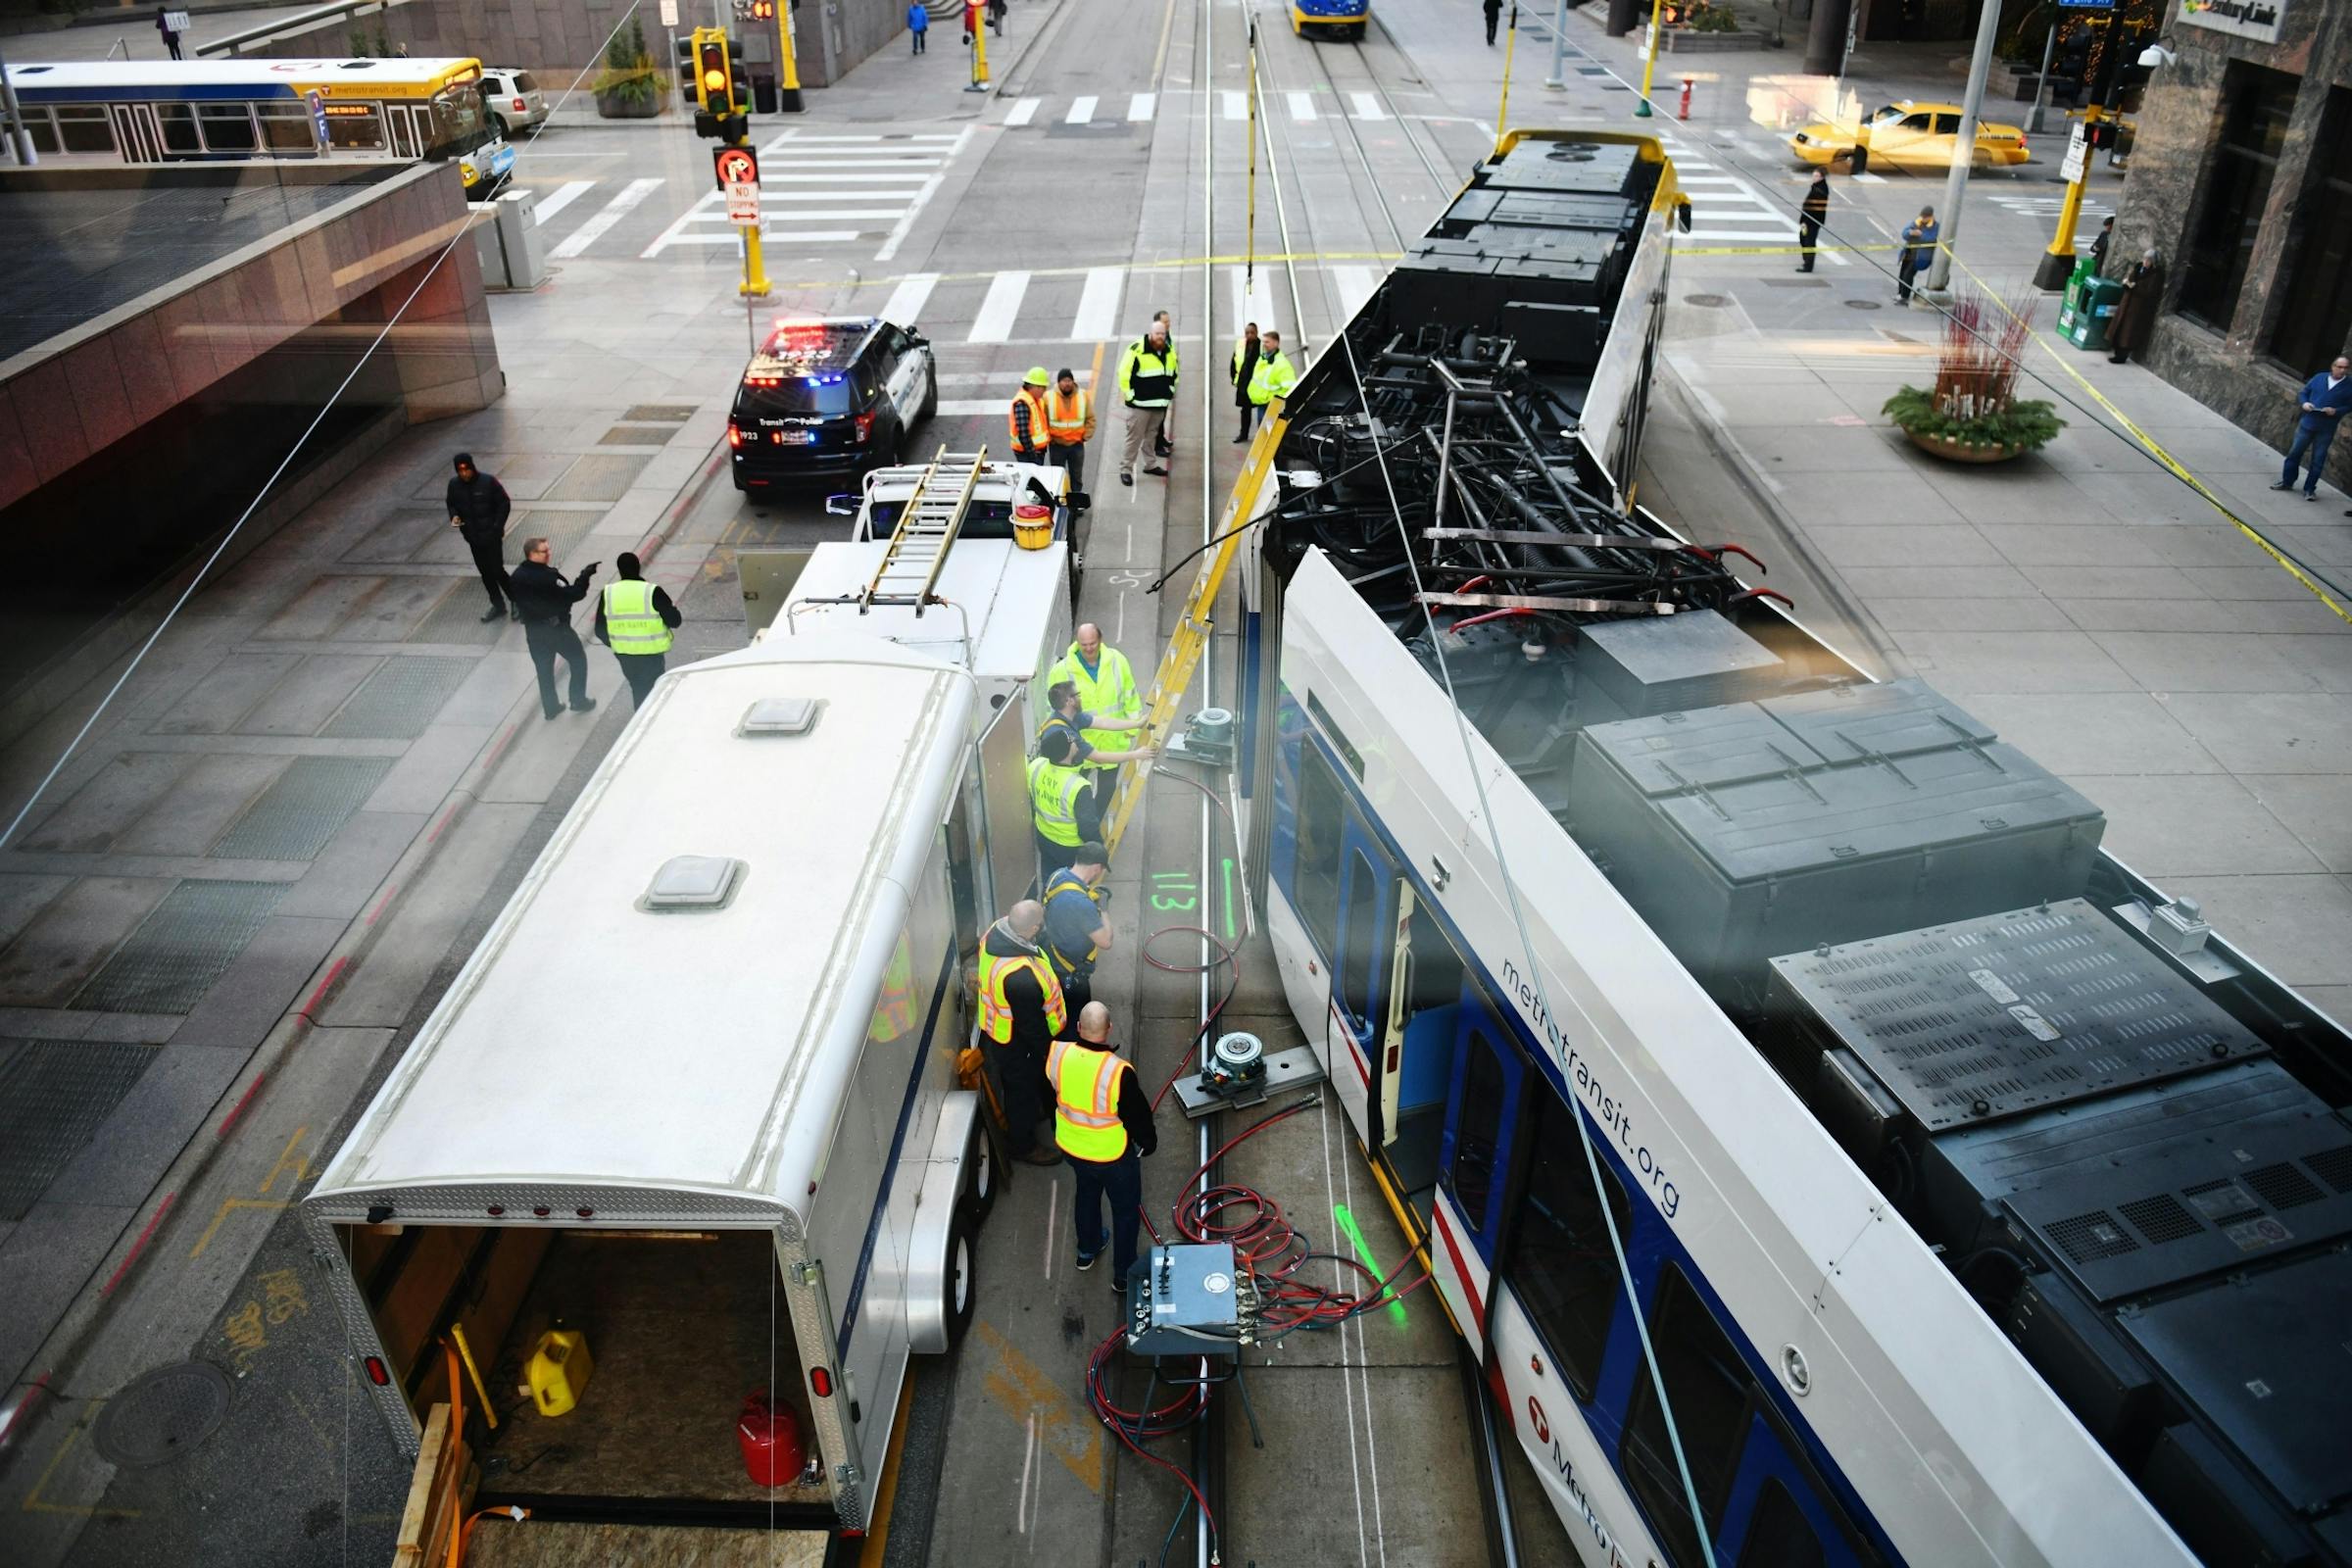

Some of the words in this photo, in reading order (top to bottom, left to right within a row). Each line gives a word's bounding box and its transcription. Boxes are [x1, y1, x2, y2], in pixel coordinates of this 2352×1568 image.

[335, 85, 408, 95] metrotransit.org
[318, 120, 325, 136] F
[735, 186, 750, 197] NO
[778, 350, 833, 361] 1923
[759, 417, 784, 426] Transit
[800, 416, 824, 425] Police
[740, 431, 759, 440] 1923
[1503, 958, 1680, 1219] metrotransit.org
[1553, 1435, 1606, 1548] Metro
